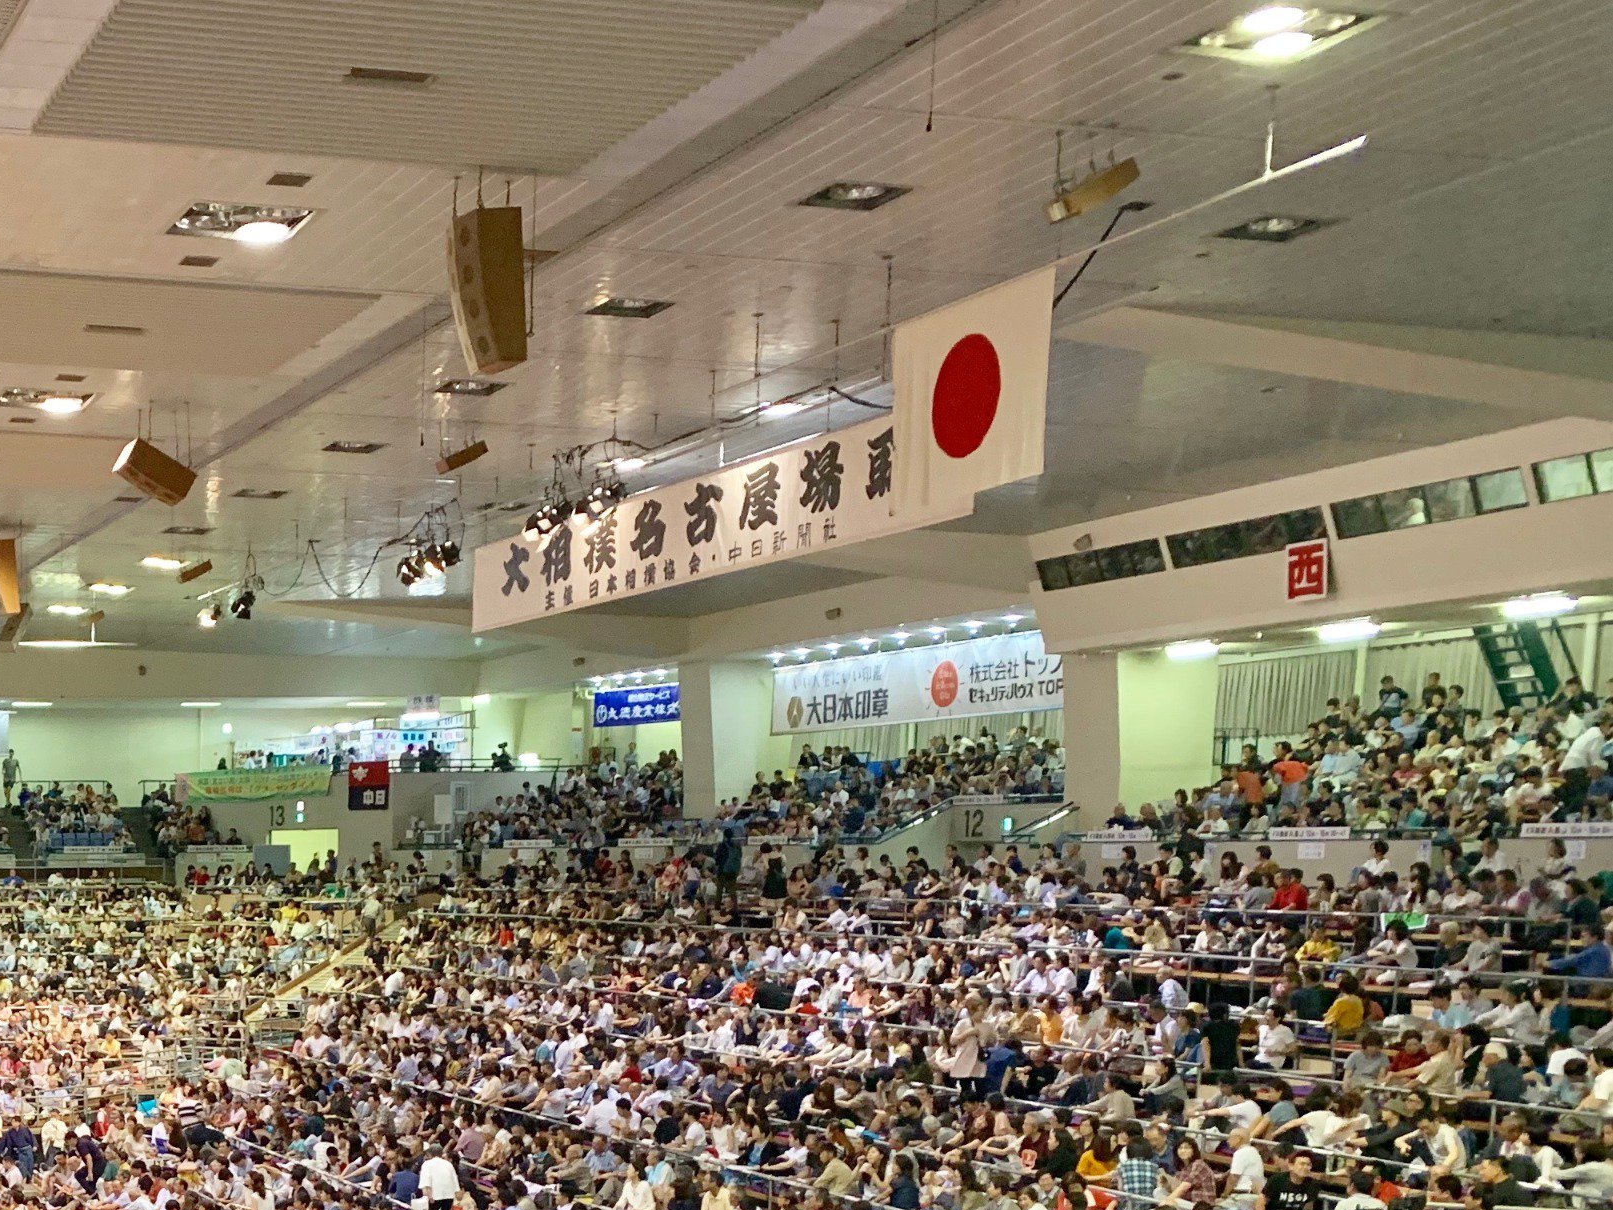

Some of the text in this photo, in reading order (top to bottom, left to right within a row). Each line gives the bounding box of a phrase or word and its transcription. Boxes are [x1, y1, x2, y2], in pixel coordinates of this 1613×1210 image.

[1288, 543, 1323, 599] 西
[969, 659, 1019, 684] 株式会社
[806, 688, 889, 726] 大日本印章
[362, 788, 386, 805] 中日
[269, 805, 286, 827] 13
[964, 809, 984, 837] 12
